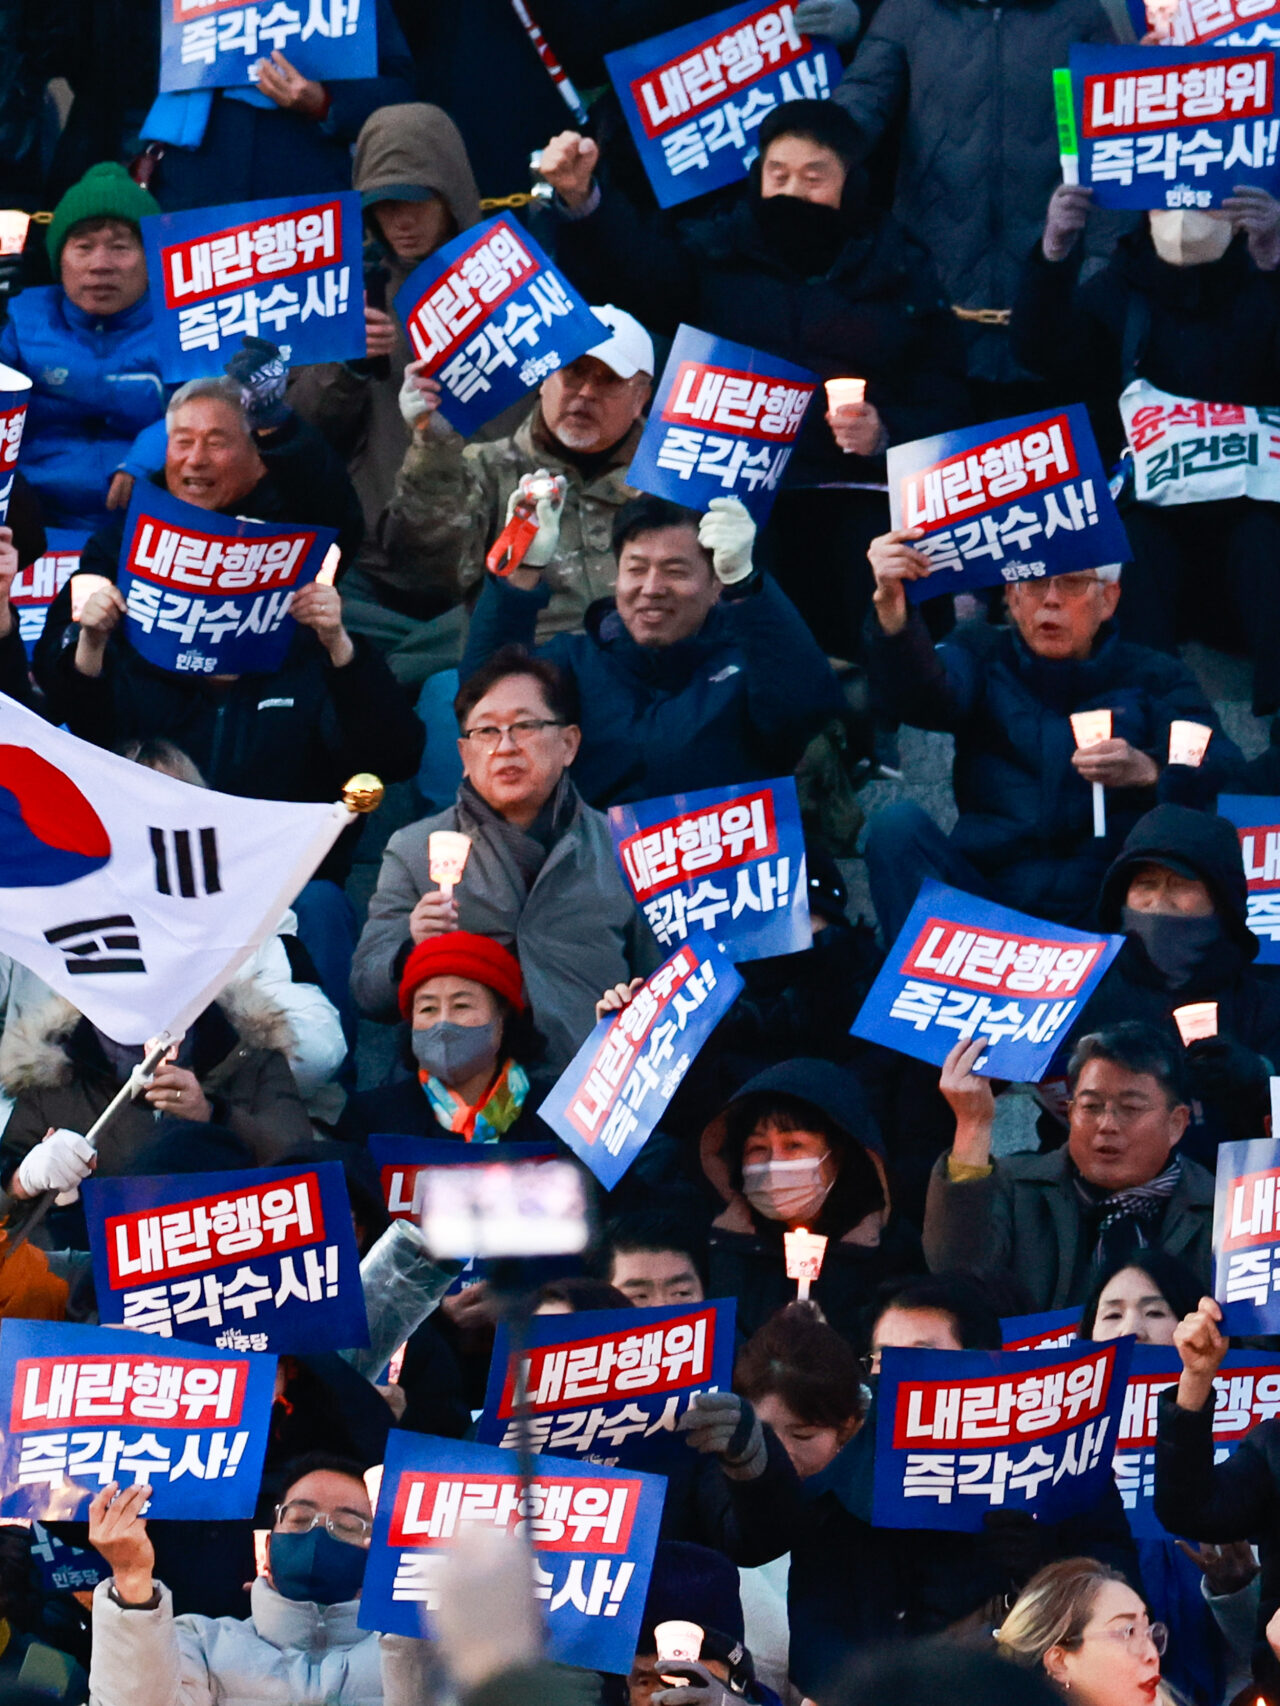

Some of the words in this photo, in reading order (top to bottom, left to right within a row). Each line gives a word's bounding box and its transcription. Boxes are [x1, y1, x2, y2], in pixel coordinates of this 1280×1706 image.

[180, 0, 359, 64] 즉각수사!
[641, 5, 802, 125] 내란행위
[1092, 61, 1266, 137] 내란행위
[1092, 120, 1279, 185] 즉각수사!
[1167, 186, 1211, 207] 민주당
[171, 210, 338, 298] 내란행위
[180, 267, 349, 351] 즉각수사!
[405, 228, 533, 362] 내란행위
[440, 273, 573, 404] 즉각수사!
[520, 351, 562, 389] 민주당
[673, 369, 813, 434] 내란행위
[1131, 403, 1246, 452] 윤석열
[908, 425, 1072, 528] 내란행위
[1146, 432, 1258, 490] 김건희
[135, 524, 304, 587] 내란행위
[914, 480, 1098, 577] 즉각수사!
[1002, 562, 1045, 580] 민주당
[127, 580, 295, 642] 즉각수사!
[176, 654, 216, 672] 민주당
[624, 799, 767, 891] 내란행위
[644, 858, 789, 945] 즉각수사!
[914, 927, 1097, 992] 내란행위
[573, 953, 691, 1131] 내란행위
[890, 981, 1076, 1043] 즉각수사!
[600, 959, 718, 1157] 즉각수사!
[116, 1183, 313, 1276] 내란행위
[122, 1245, 337, 1337] 즉각수사!
[22, 1363, 236, 1419] 내란행위
[511, 1320, 706, 1407] 내란행위
[907, 1357, 1106, 1439] 내란행위
[18, 1431, 249, 1488] 즉각수사!
[904, 1418, 1110, 1504] 즉각수사!
[400, 1482, 628, 1548] 내란행위
